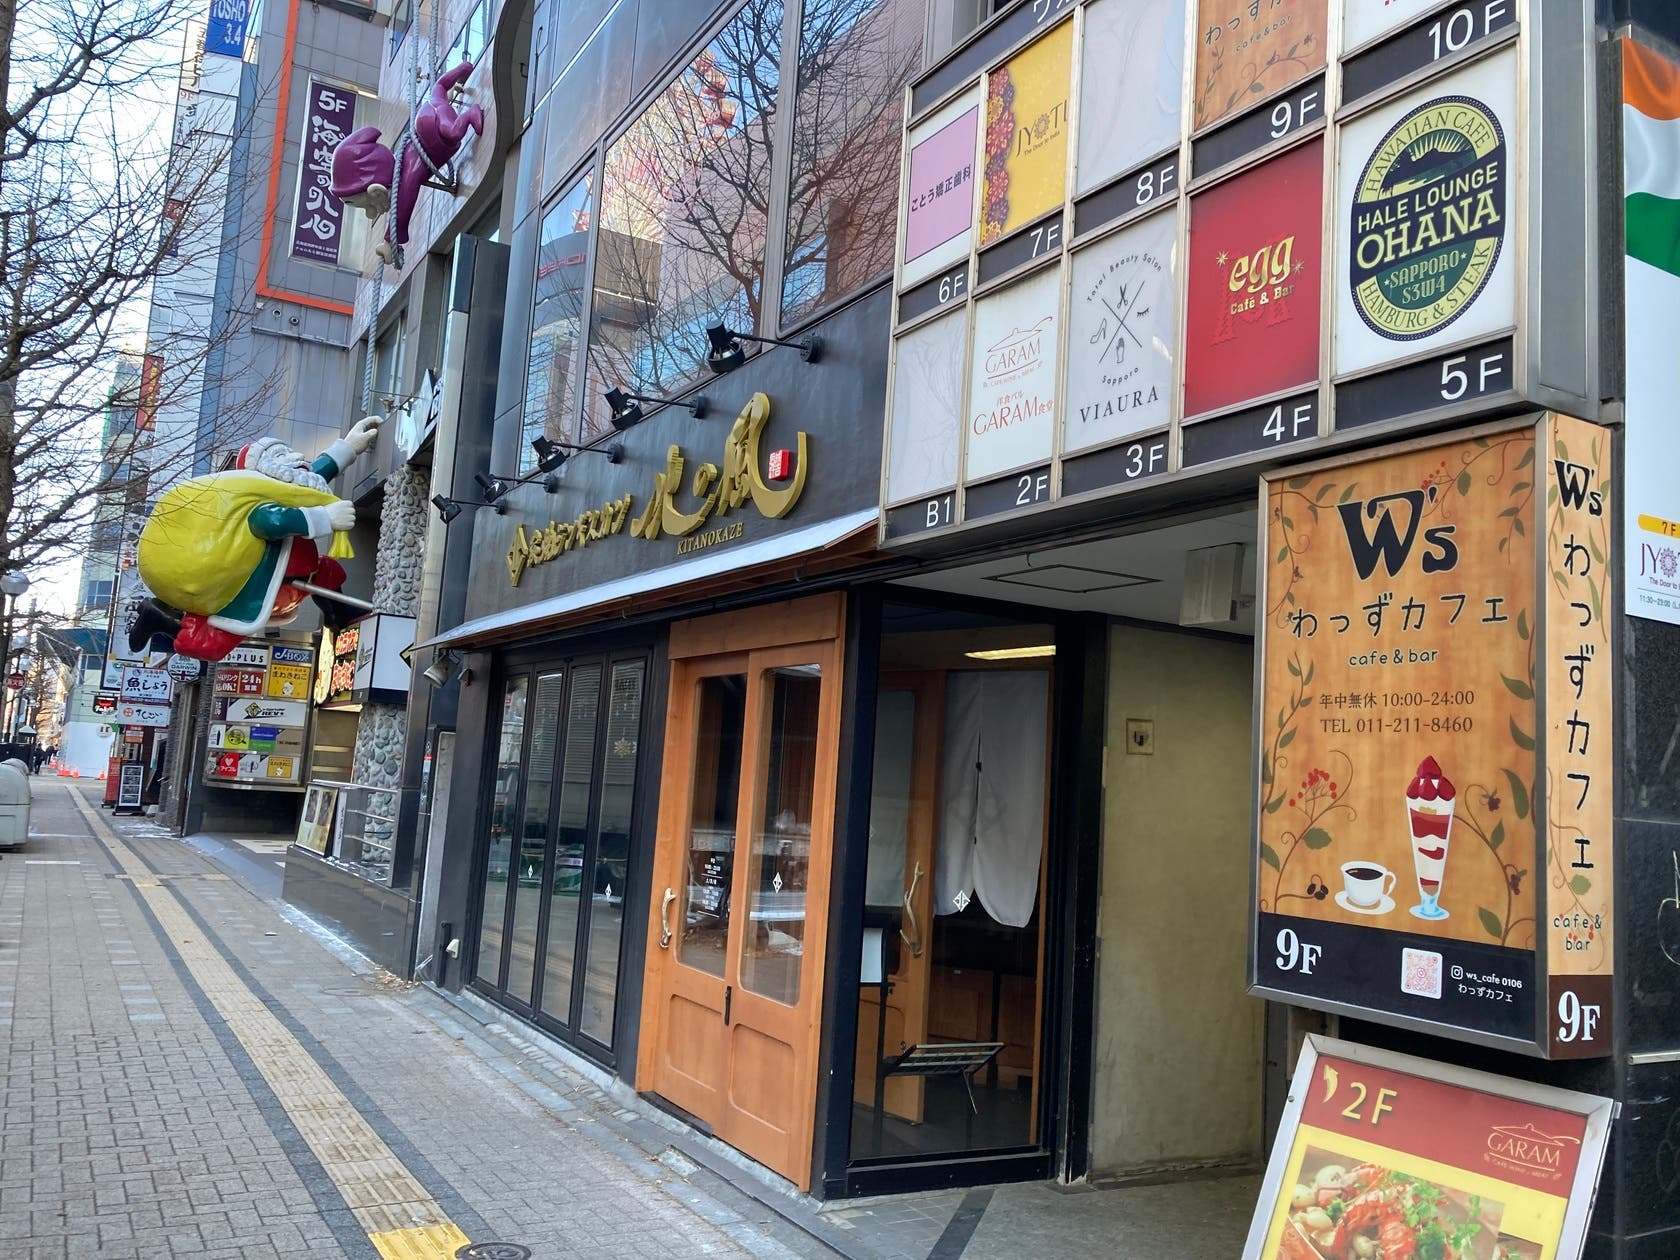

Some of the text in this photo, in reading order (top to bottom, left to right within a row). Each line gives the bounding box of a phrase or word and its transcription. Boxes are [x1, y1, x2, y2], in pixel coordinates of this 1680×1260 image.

[224, 22, 242, 46] 3.4
[1428, 0, 1507, 60] 10F
[318, 89, 347, 113] 5F
[1270, 91, 1318, 139] 9F
[1366, 110, 1490, 193] HAWAIIAN CAFE
[911, 164, 972, 212] ことう矯正歯科
[1136, 165, 1175, 206] 8F
[1358, 161, 1498, 233] HALE LOUNGE
[1030, 224, 1059, 258] 7F
[1357, 189, 1500, 269] OHANA
[1087, 253, 1162, 301] Total Beauty Salon
[1229, 236, 1295, 293] egg
[1389, 250, 1460, 288] SAPPORO
[938, 273, 964, 303] 6F
[1259, 292, 1270, 305] &
[1273, 283, 1296, 301] Bar
[1362, 243, 1491, 329] HAMBURG & STEAK
[1402, 275, 1445, 303] S3W4
[985, 338, 1041, 373] GARAM
[1102, 367, 1139, 386] Sapporo
[1440, 353, 1503, 400] 5F
[1079, 385, 1159, 424] VIAURA
[1262, 404, 1312, 442] 4F
[1125, 443, 1164, 478] 3F
[1015, 474, 1048, 505] 2F
[1554, 459, 1602, 516] W's
[926, 497, 950, 527] B1
[1661, 521, 1676, 537] 7F
[677, 522, 744, 556] KITANOKAZE
[1337, 486, 1459, 580] W's
[1640, 543, 1680, 578] JYO
[1649, 577, 1658, 586] The
[1660, 579, 1671, 588] Door
[1291, 592, 1509, 638] わっずカフェ
[125, 677, 168, 692] 魚しょう
[242, 674, 262, 684] 24h
[1319, 690, 1475, 710] 年中無休 10:00-24:00
[1564, 534, 1595, 869] わっずカフェ
[1320, 717, 1473, 734] TEL 011-211-8460
[1553, 914, 1602, 929] cafe &
[1275, 928, 1322, 976] 9F
[1565, 935, 1591, 951] bar
[1458, 983, 1513, 1003] わっずカフェ
[1502, 978, 1523, 989] 0106
[1558, 990, 1601, 1043] 9F
[1341, 1081, 1399, 1125] 2F
[1487, 1132, 1560, 1167] GARAM
